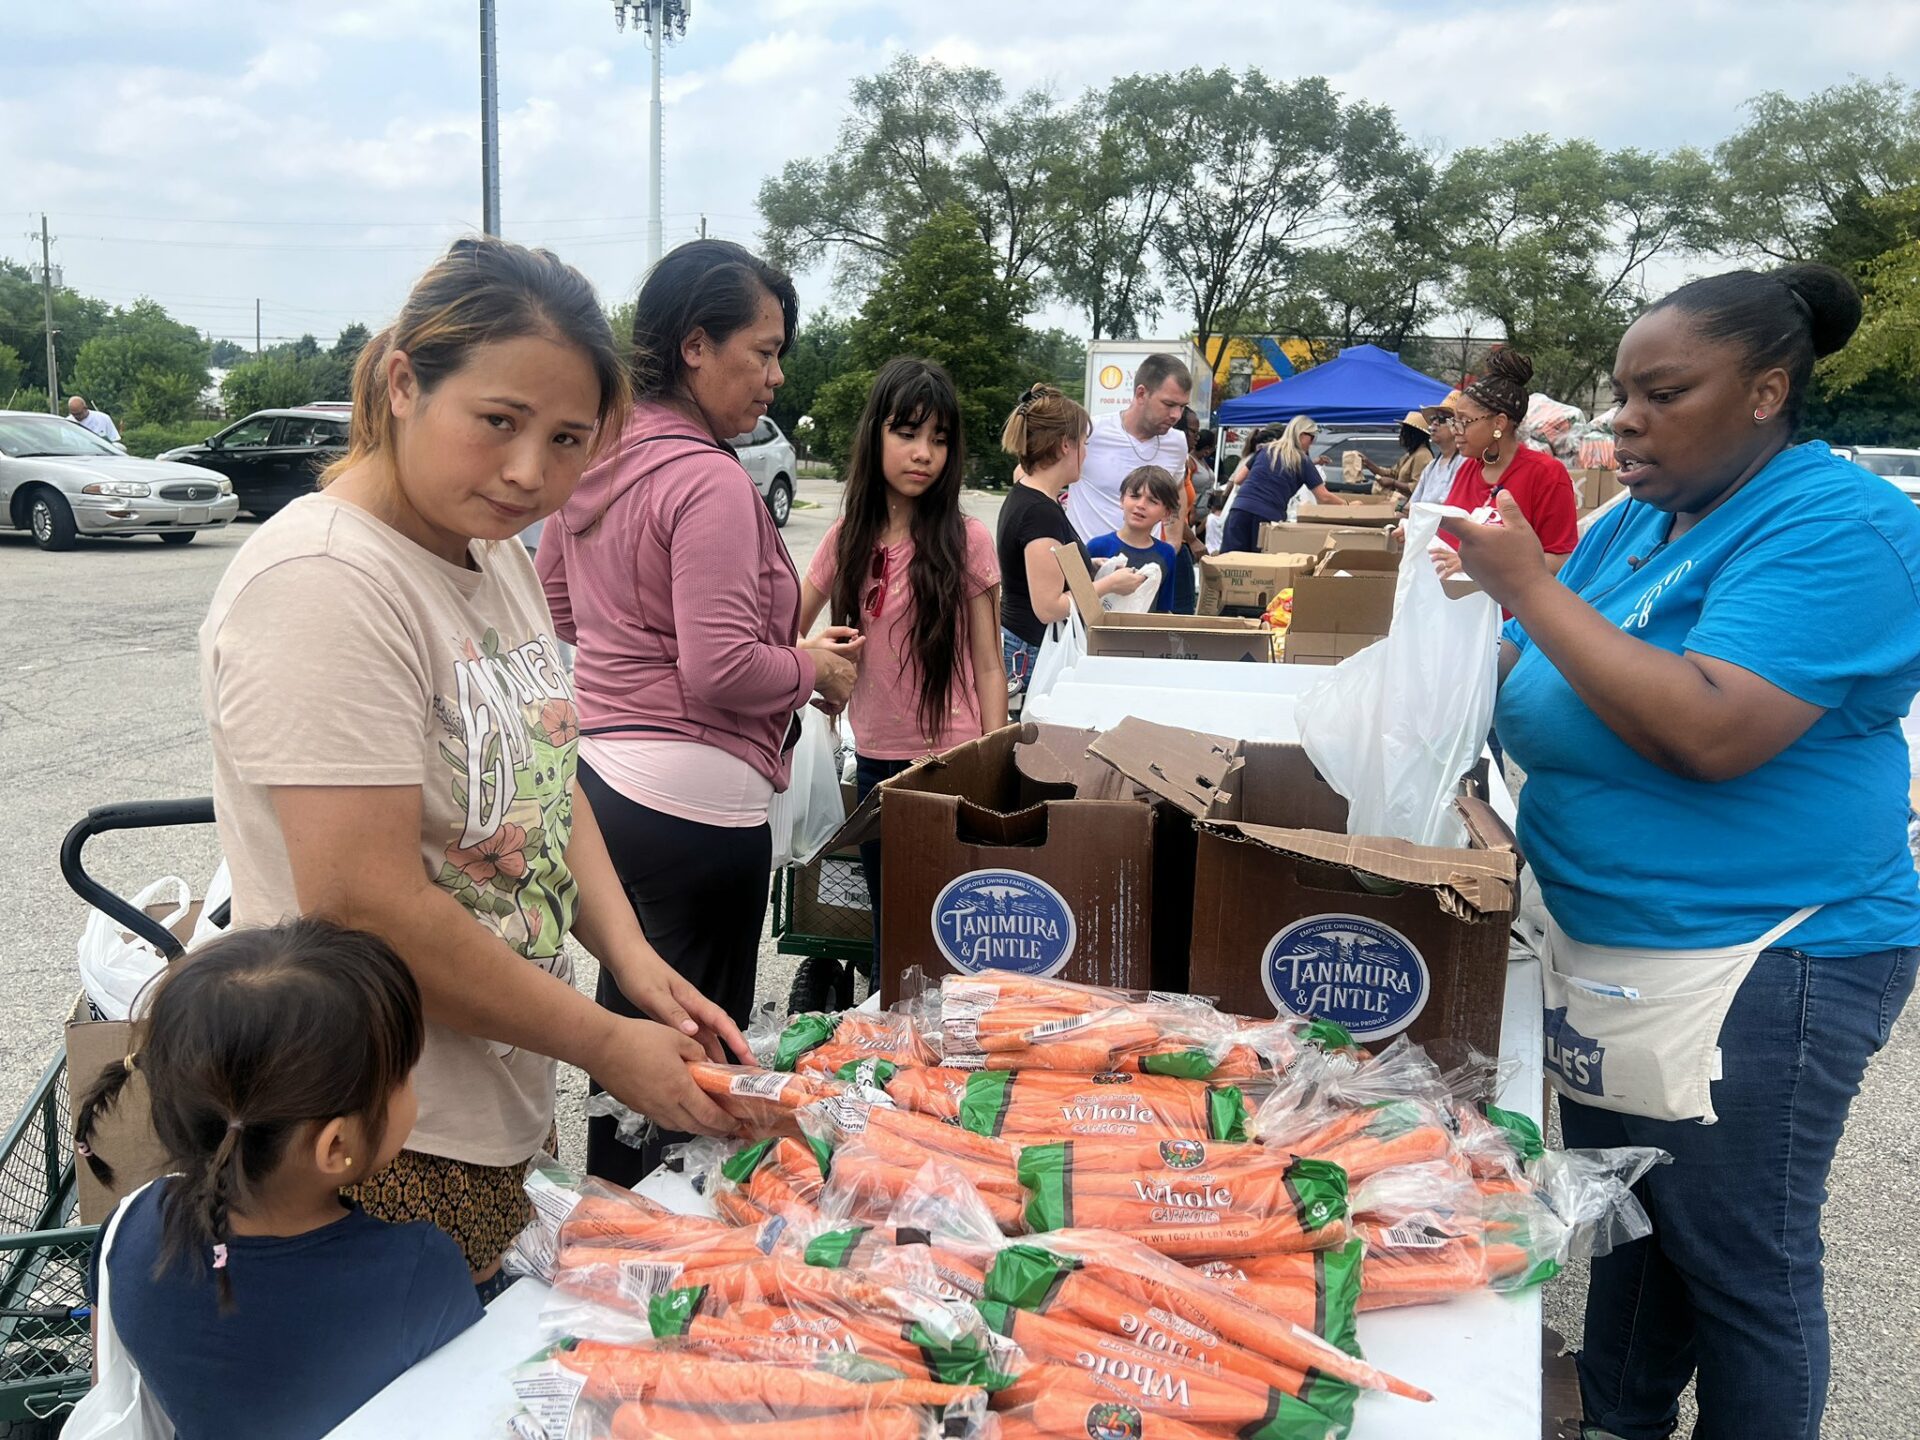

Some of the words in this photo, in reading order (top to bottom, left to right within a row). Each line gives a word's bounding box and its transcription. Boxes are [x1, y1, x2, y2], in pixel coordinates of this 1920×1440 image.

[959, 879, 986, 893] EMPLOYEE
[1009, 879, 1031, 890] FAMILY
[1030, 887, 1046, 899] FARM
[941, 905, 1060, 942] TANIMURA
[1299, 924, 1333, 938] EMPLOYEE
[1333, 923, 1359, 931] OWNED
[1359, 926, 1385, 939] FAMILY
[1382, 935, 1400, 949] FARM
[961, 942, 971, 956] &
[962, 935, 1042, 966] ANTLE
[1275, 951, 1412, 994] TANIMURA
[1296, 990, 1307, 1005] &
[1297, 984, 1389, 1014] ANTLE
[1360, 1015, 1387, 1027] PRODUCE
[1060, 1103, 1153, 1124] Whole
[1132, 1179, 1233, 1208] Whole
[1151, 1208, 1220, 1224] CARROTS
[1076, 1351, 1192, 1409] Whole
